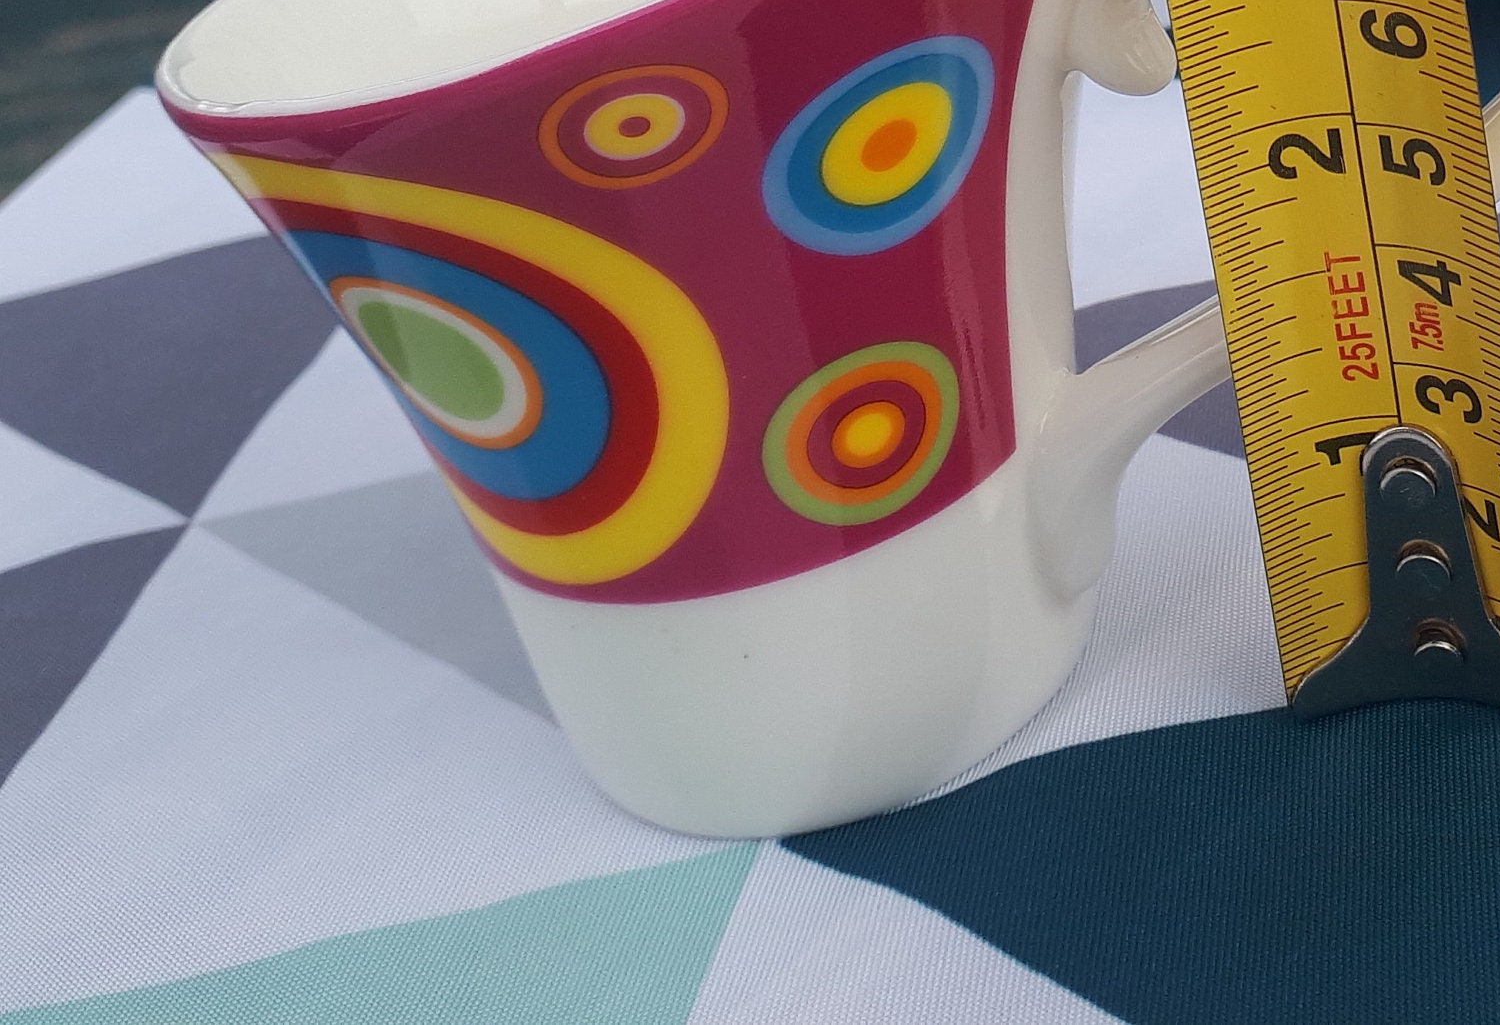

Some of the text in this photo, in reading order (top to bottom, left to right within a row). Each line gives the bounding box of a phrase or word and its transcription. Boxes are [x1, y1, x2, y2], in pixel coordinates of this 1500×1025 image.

[1360, 8, 1428, 60] 6
[1268, 127, 1347, 180] 2
[1380, 134, 1446, 187] 5
[1397, 259, 1462, 307] 4
[1409, 302, 1445, 352] 7.5m
[1415, 374, 1482, 424] 3
[1315, 431, 1374, 467] 1
